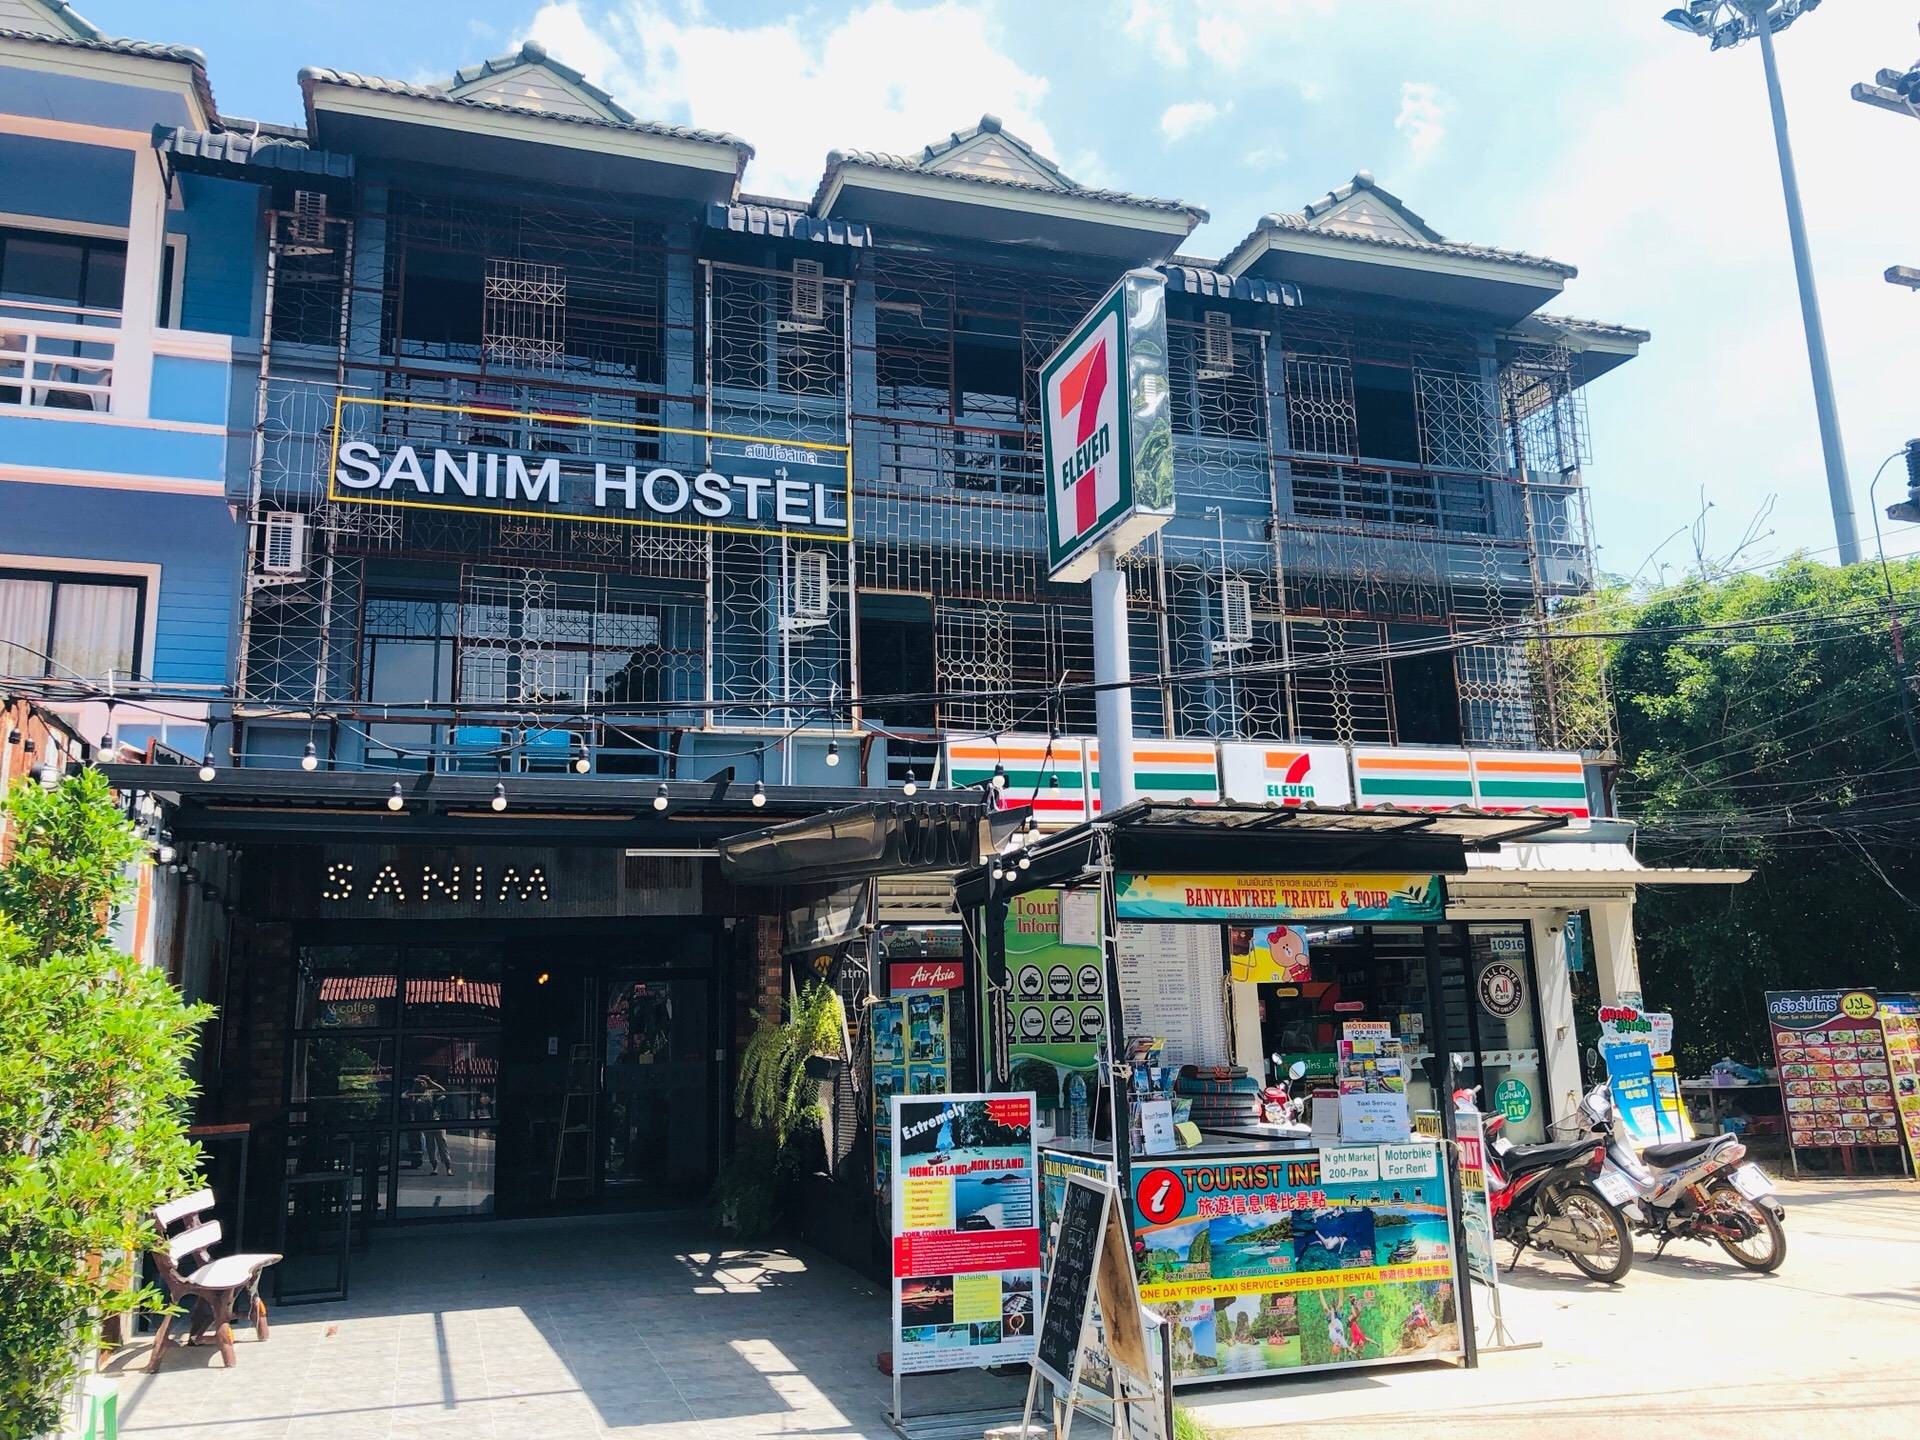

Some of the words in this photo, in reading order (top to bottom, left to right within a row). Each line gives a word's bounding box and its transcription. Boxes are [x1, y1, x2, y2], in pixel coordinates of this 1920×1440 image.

[336, 441, 559, 503] SANIM
[595, 462, 846, 527] HOSTEL
[323, 863, 549, 901] SANIM
[1014, 896, 1059, 916] Touri
[1185, 888, 1278, 908] BANYANTREE
[1282, 889, 1334, 909] TRAVEL
[1340, 890, 1350, 909] &
[1354, 890, 1389, 909] TOUR
[1492, 939, 1524, 951] 10916
[1483, 967, 1498, 986] ALL
[1770, 996, 1837, 1014] ครัวร่มไทร
[902, 1103, 965, 1140] Extremely
[1348, 1152, 1376, 1162] Market
[1385, 1147, 1432, 1161] Motorbike
[909, 1166, 934, 1178] HONG
[936, 1164, 968, 1176] ISLAND
[993, 1157, 1025, 1170] ISLAND
[1389, 1163, 1404, 1175] For
[1406, 1163, 1428, 1174] Rent
[1182, 1164, 1282, 1193] TOURIST
[1197, 1190, 1327, 1217] 旅遊信息喀比景點
[958, 1273, 989, 1281] Inclusions
[1140, 1287, 1160, 1300] ONE
[1163, 1286, 1183, 1298] DAY
[1186, 1285, 1213, 1296] TRIPS
[1217, 1283, 1238, 1294] TAXI
[1240, 1279, 1280, 1292] SERVICE
[1284, 1276, 1314, 1289] SPEED
[1316, 1274, 1340, 1286] BOAT
[1342, 1271, 1377, 1283] RENTAL
